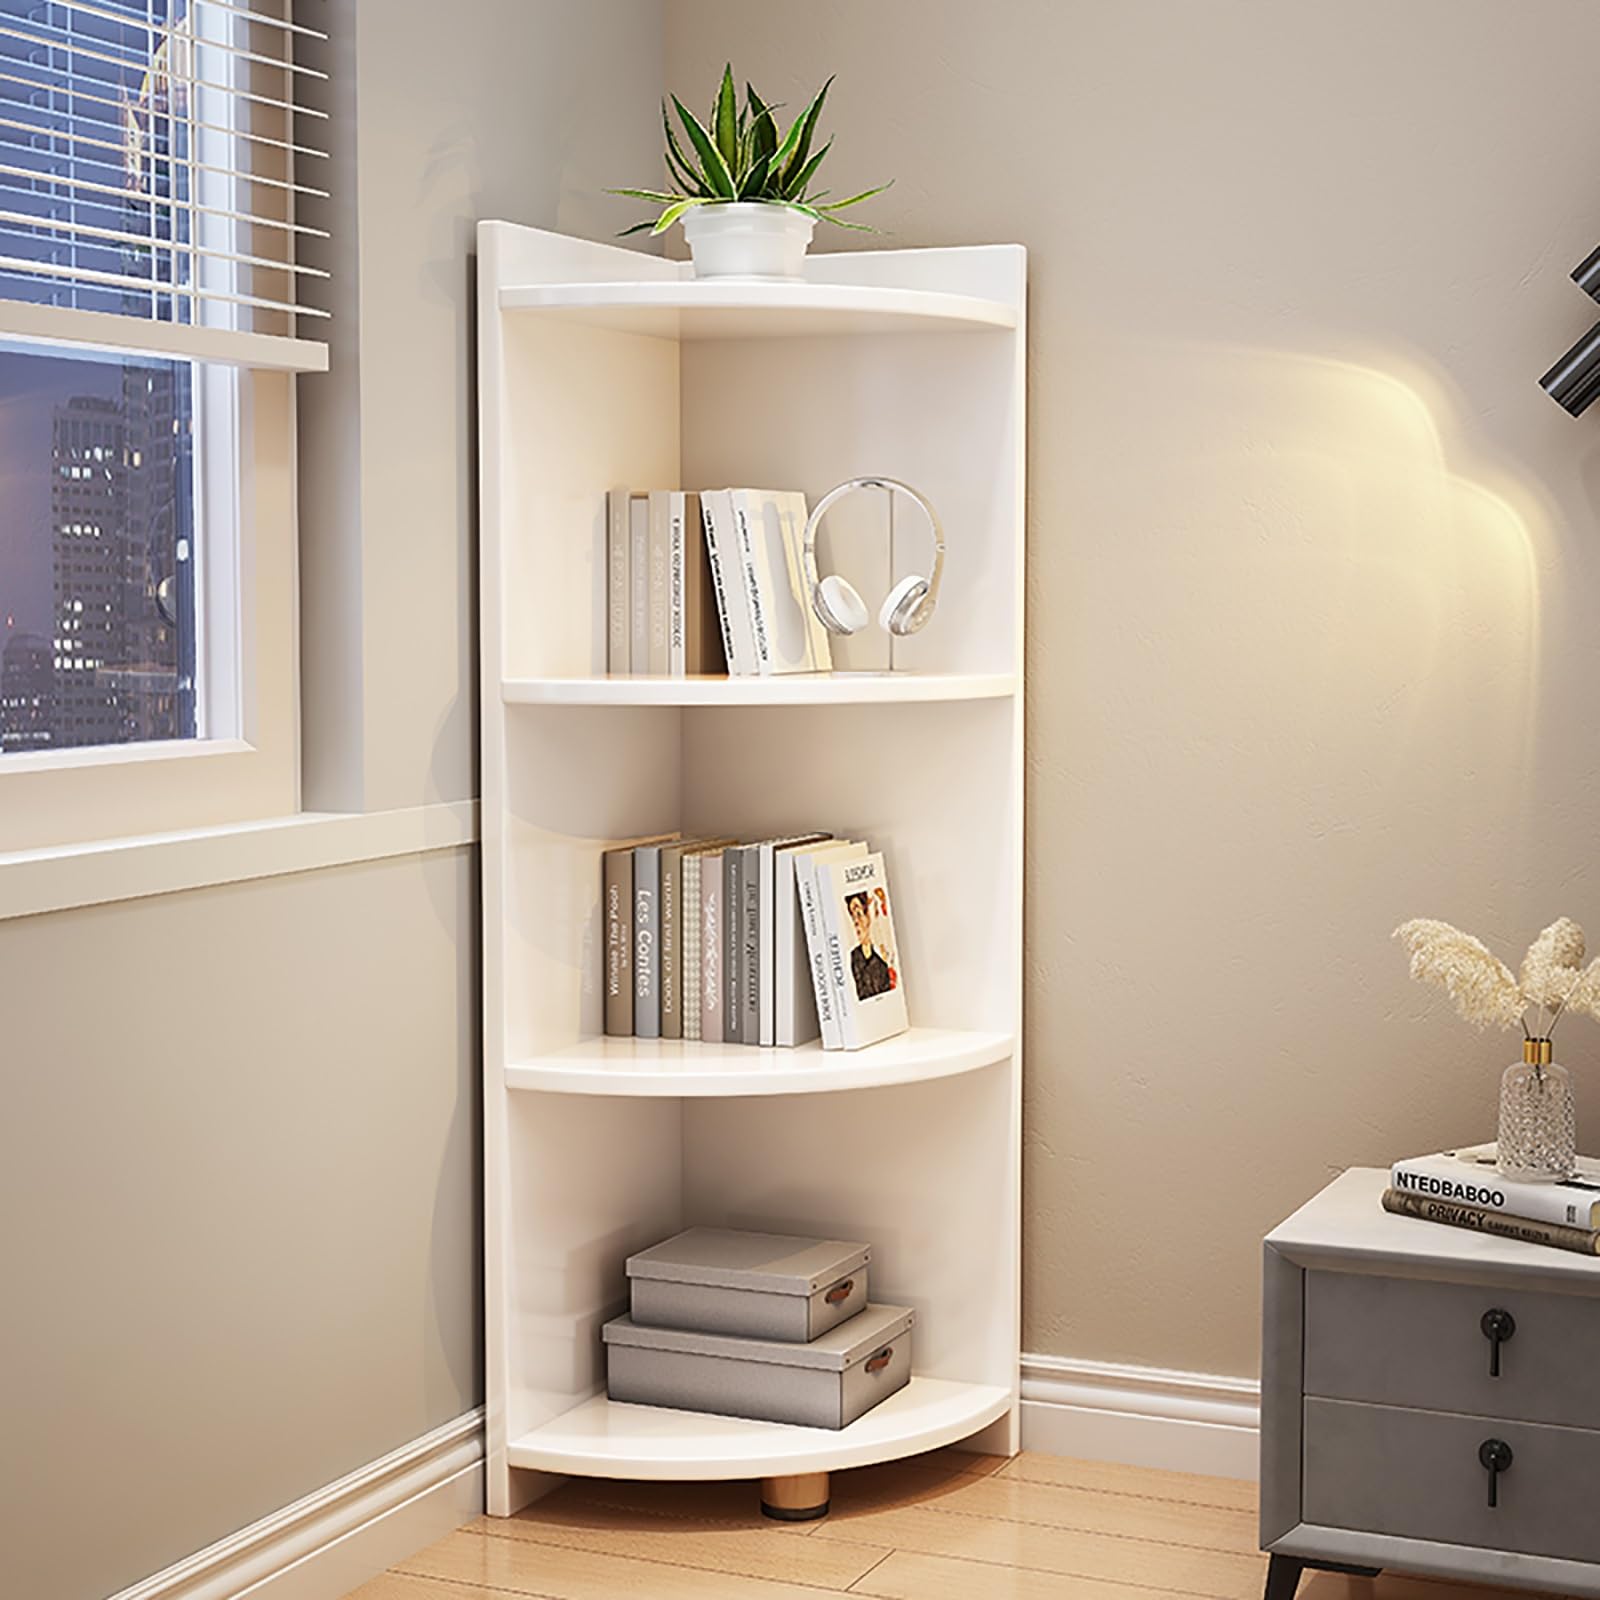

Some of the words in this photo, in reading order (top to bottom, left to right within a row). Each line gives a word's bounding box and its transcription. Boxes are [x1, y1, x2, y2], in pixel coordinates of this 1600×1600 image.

[637, 890, 652, 923] Les
[609, 922, 618, 945] The
[638, 930, 652, 997] Contes
[664, 956, 672, 972] of
[664, 976, 672, 1013] book
[1396, 1171, 1505, 1207] NTEDBABOO
[1428, 1203, 1487, 1228] PRIVACY
